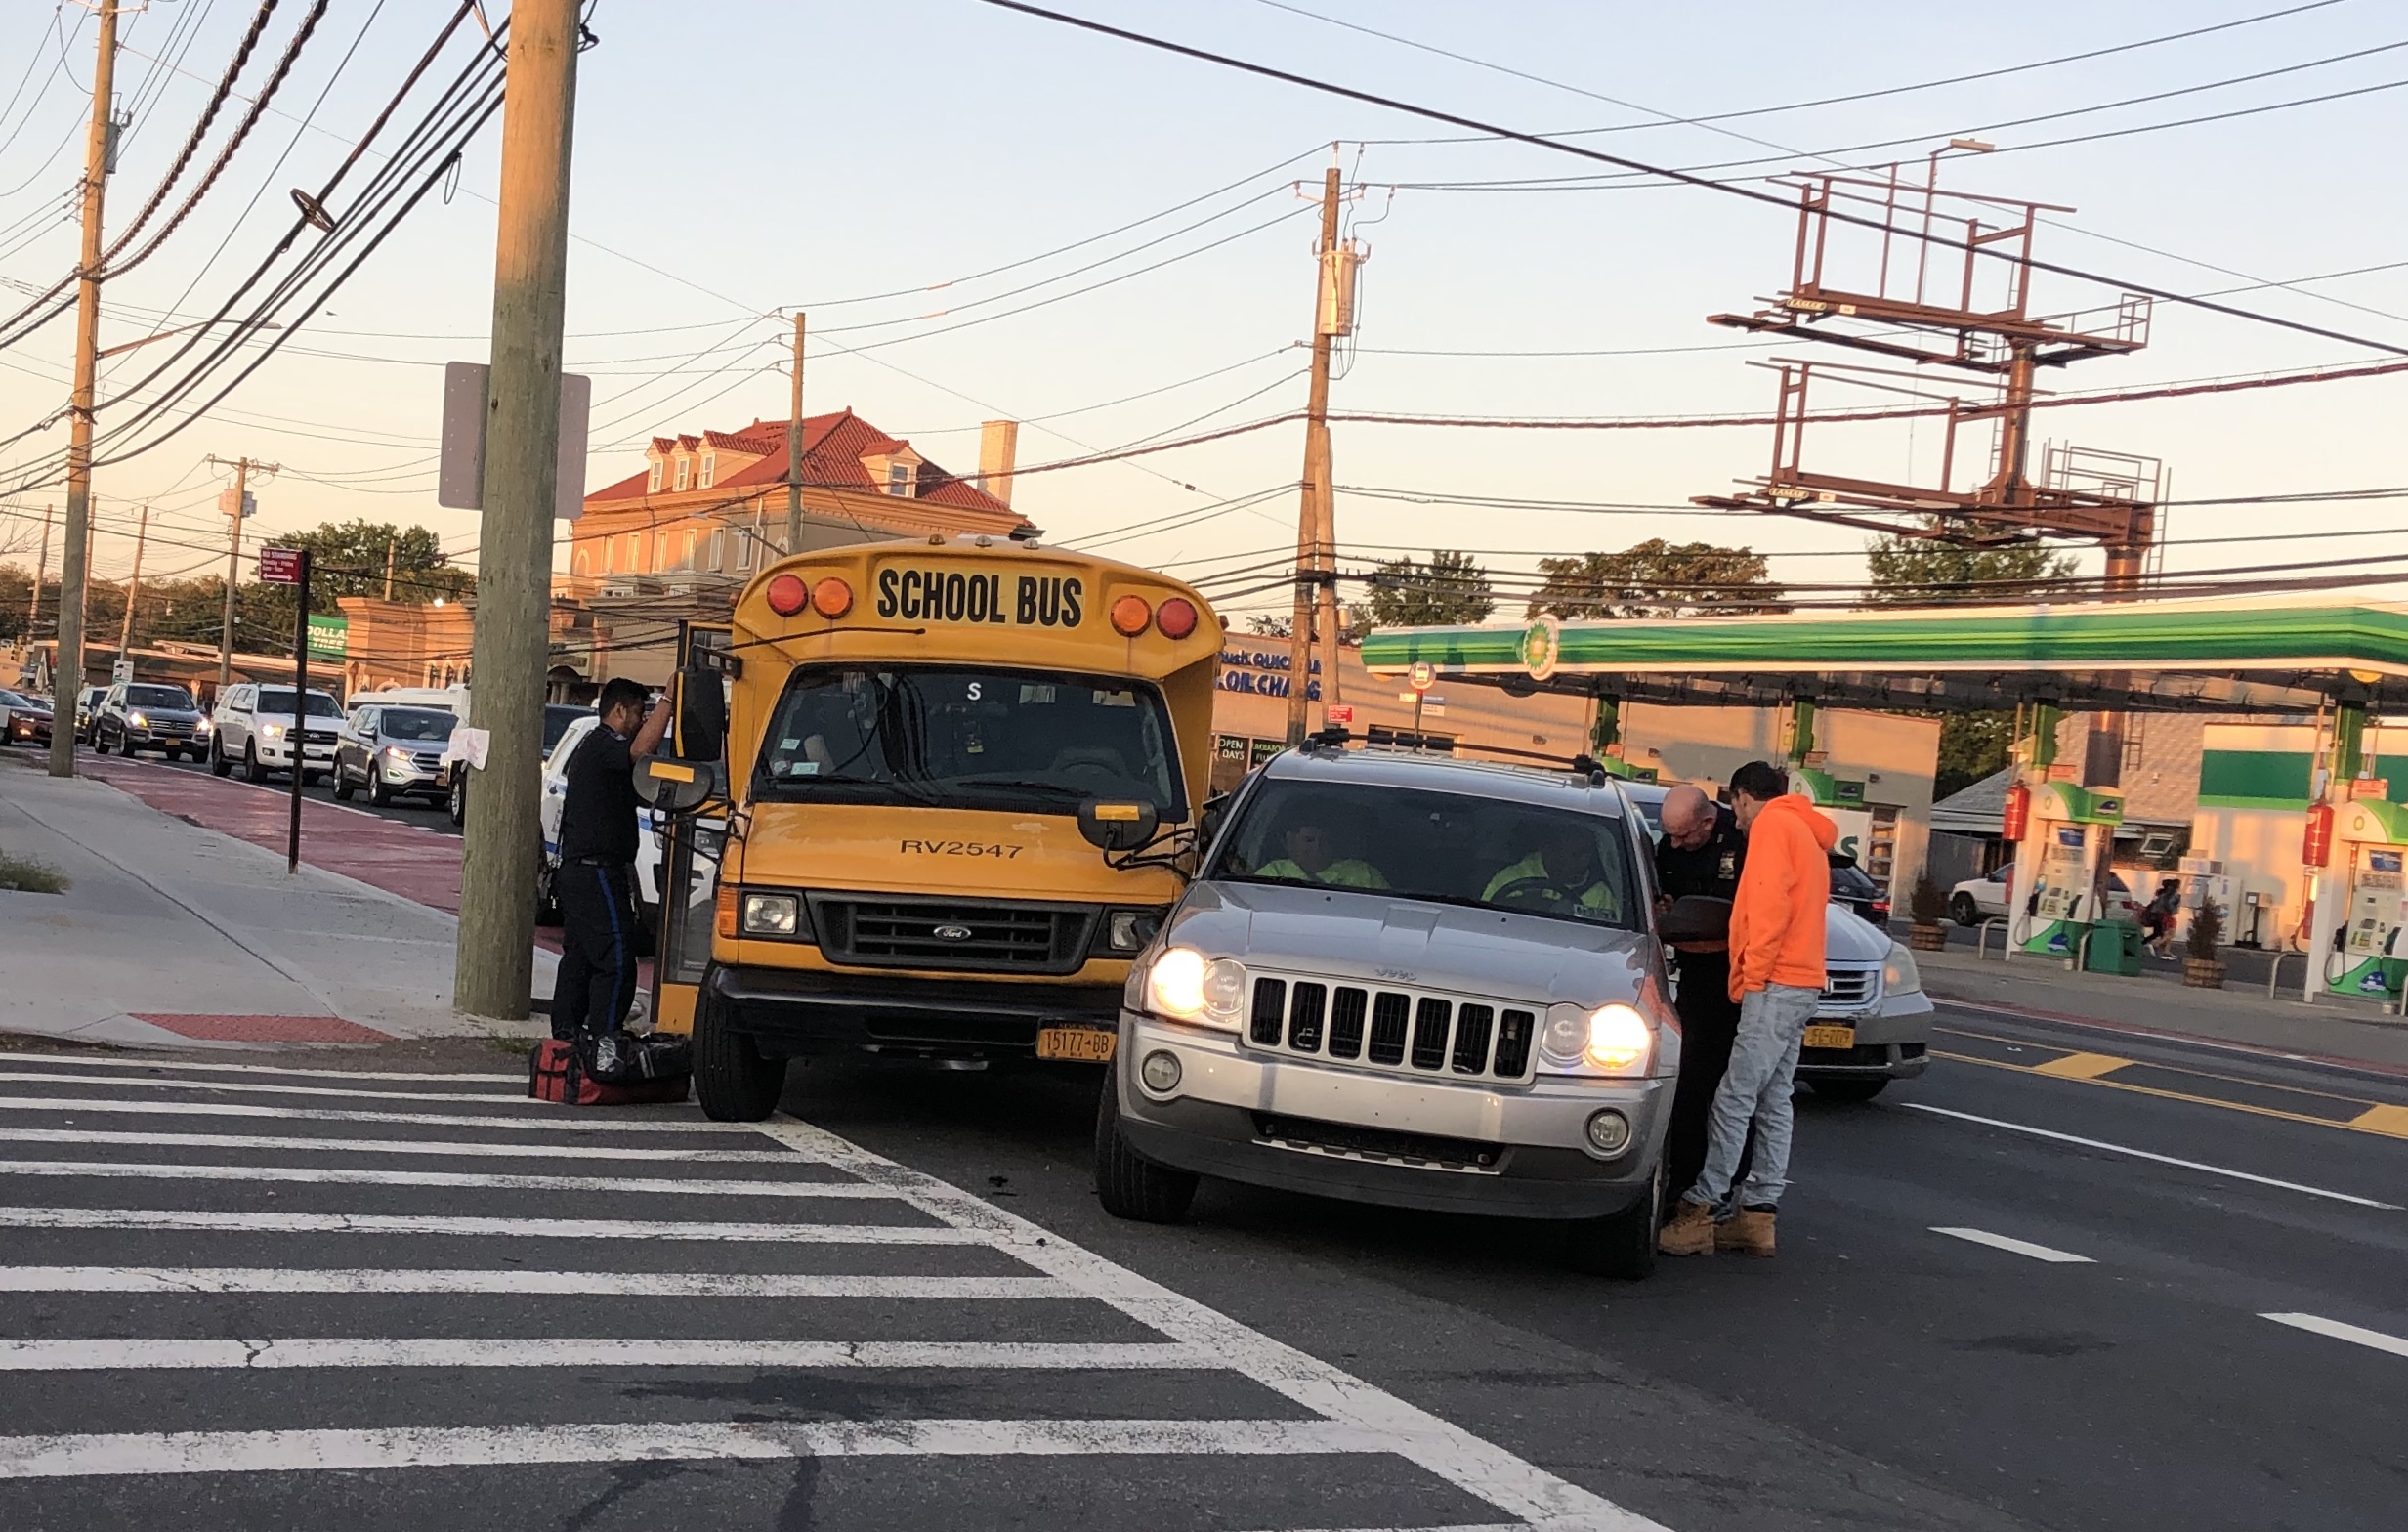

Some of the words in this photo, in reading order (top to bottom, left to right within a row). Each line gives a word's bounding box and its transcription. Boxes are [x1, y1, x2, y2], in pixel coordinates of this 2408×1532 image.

[877, 569, 1006, 623] SCHOOL
[1016, 576, 1082, 628] BUS
[308, 626, 348, 640] DOLLA
[1252, 652, 1291, 671] QUIC
[1224, 670, 1253, 693] OIL
[967, 682, 982, 701] S
[1219, 738, 1244, 750] OPEN
[1222, 749, 1246, 761] DAYS
[900, 839, 1024, 859] RV2547
[942, 927, 963, 938] Ford
